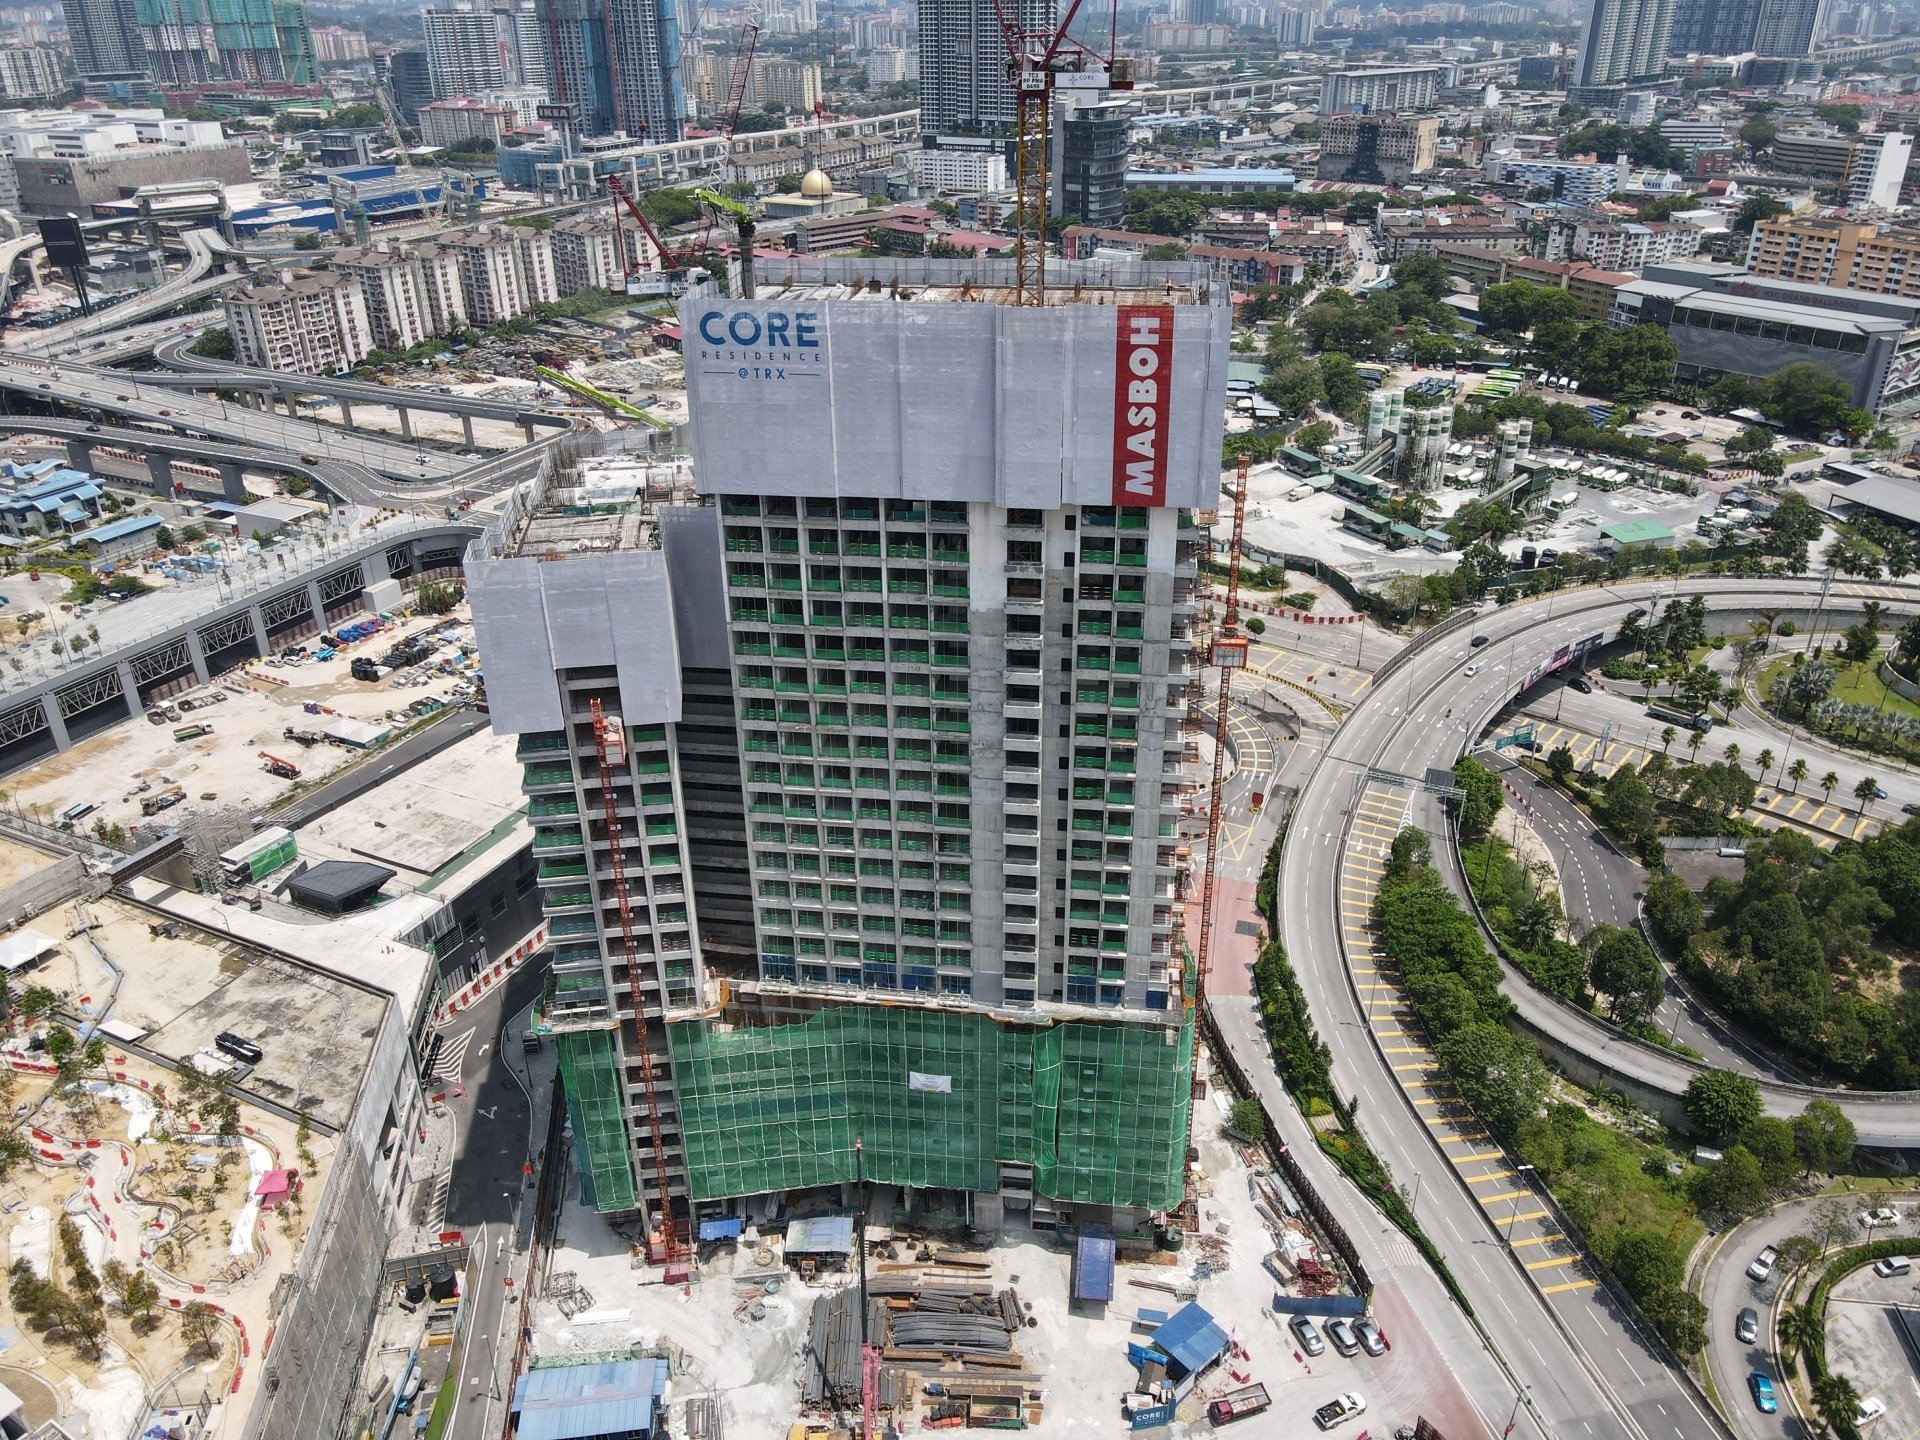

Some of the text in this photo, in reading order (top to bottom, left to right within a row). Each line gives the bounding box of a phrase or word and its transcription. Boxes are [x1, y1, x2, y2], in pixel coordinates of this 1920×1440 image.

[539, 108, 568, 117] IKEA
[699, 311, 819, 347] CORE
[701, 351, 821, 361] RESIDENCE
[738, 367, 786, 379] @TRX
[1125, 317, 1160, 496] MASBOH
[1136, 1411, 1161, 1421] CORE
